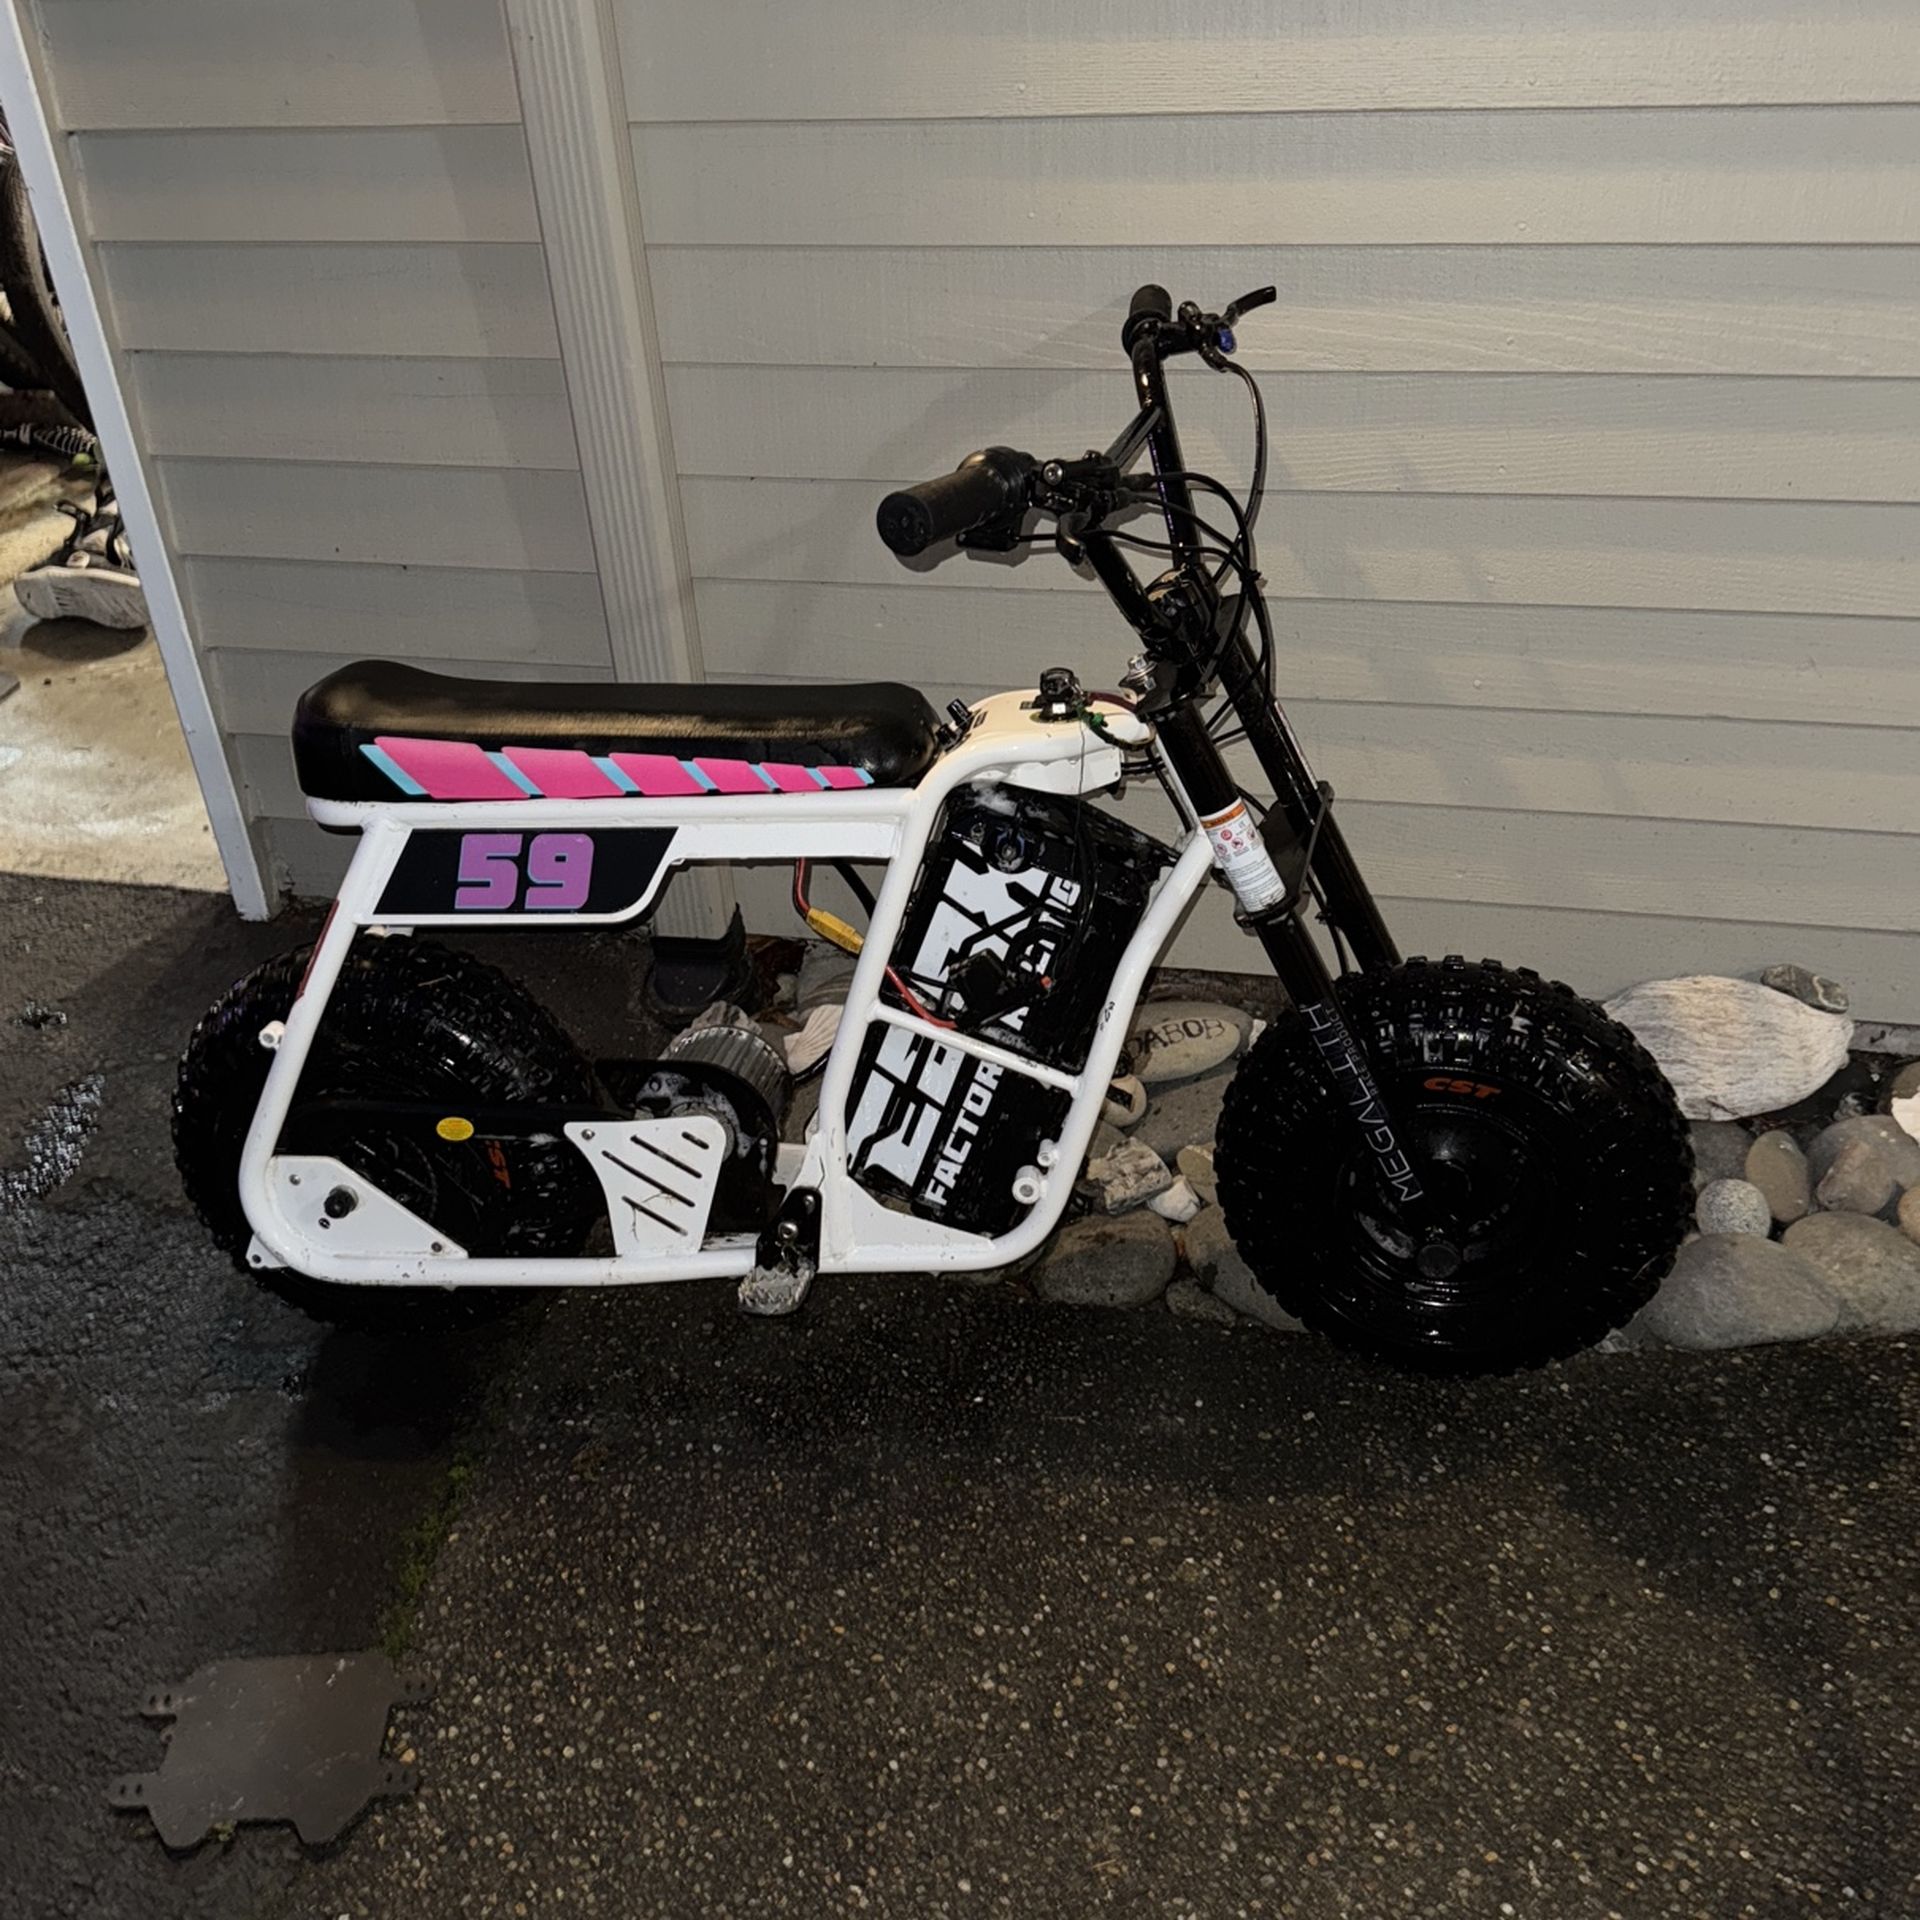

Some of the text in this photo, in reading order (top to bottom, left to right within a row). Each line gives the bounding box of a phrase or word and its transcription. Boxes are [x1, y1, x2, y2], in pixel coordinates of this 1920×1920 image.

[454, 833, 595, 910] 59
[1300, 1003, 1424, 1201] MEGALITH
[1424, 1077, 1501, 1098] CST
